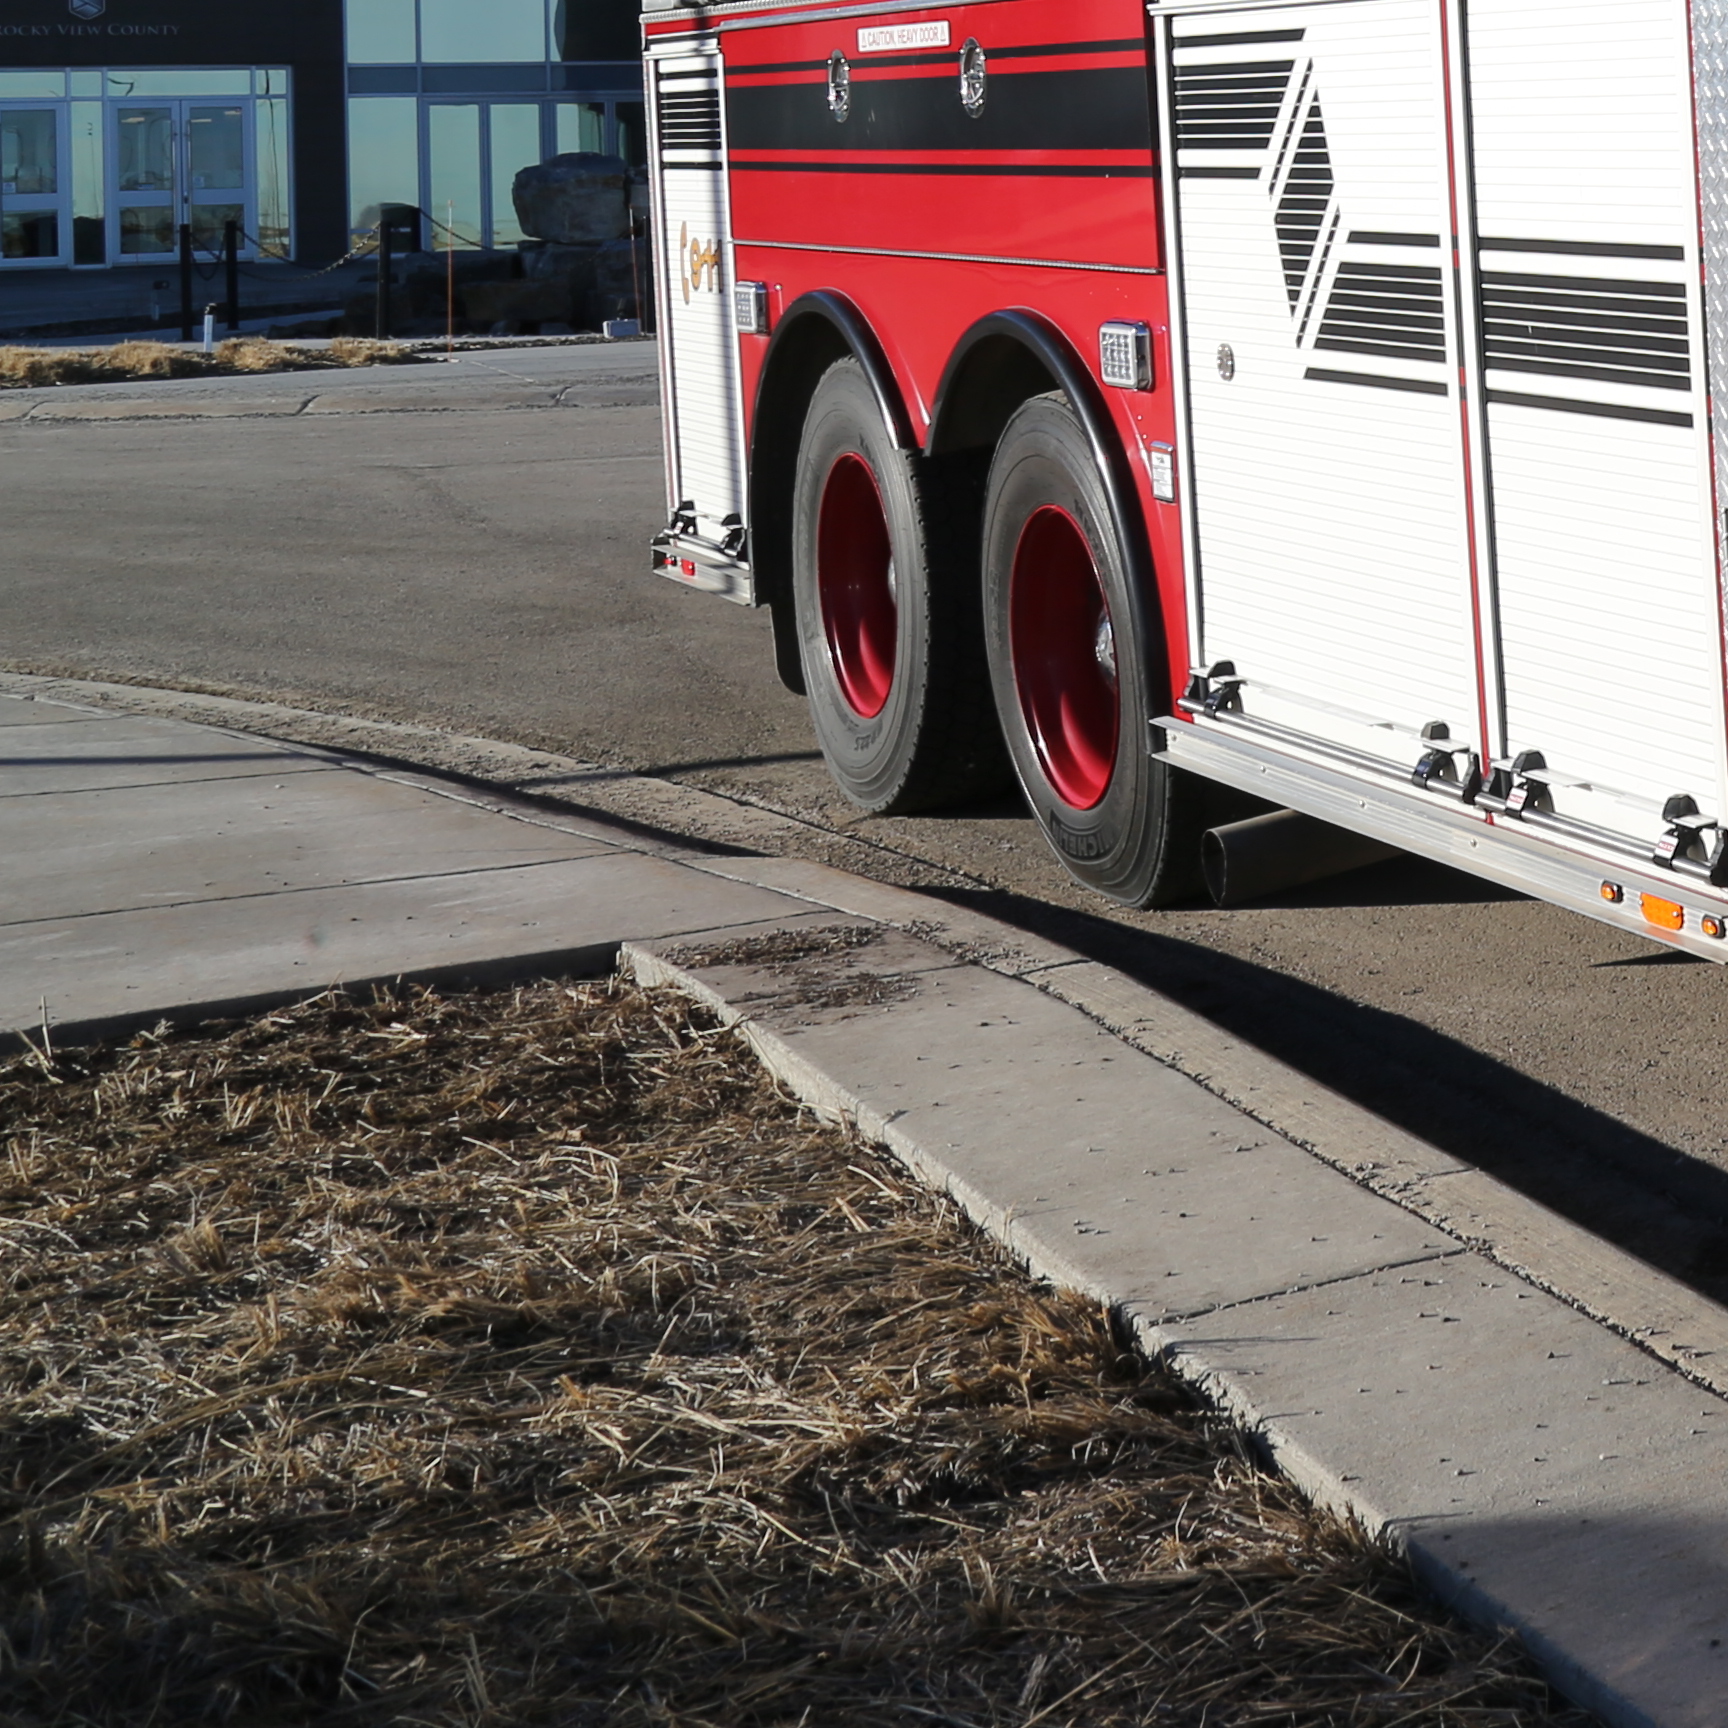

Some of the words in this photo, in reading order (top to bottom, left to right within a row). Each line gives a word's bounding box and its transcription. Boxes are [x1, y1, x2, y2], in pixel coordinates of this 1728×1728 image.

[898, 27, 919, 44] HEAVY
[919, 25, 939, 42] DOOR
[690, 237, 724, 293] 911
